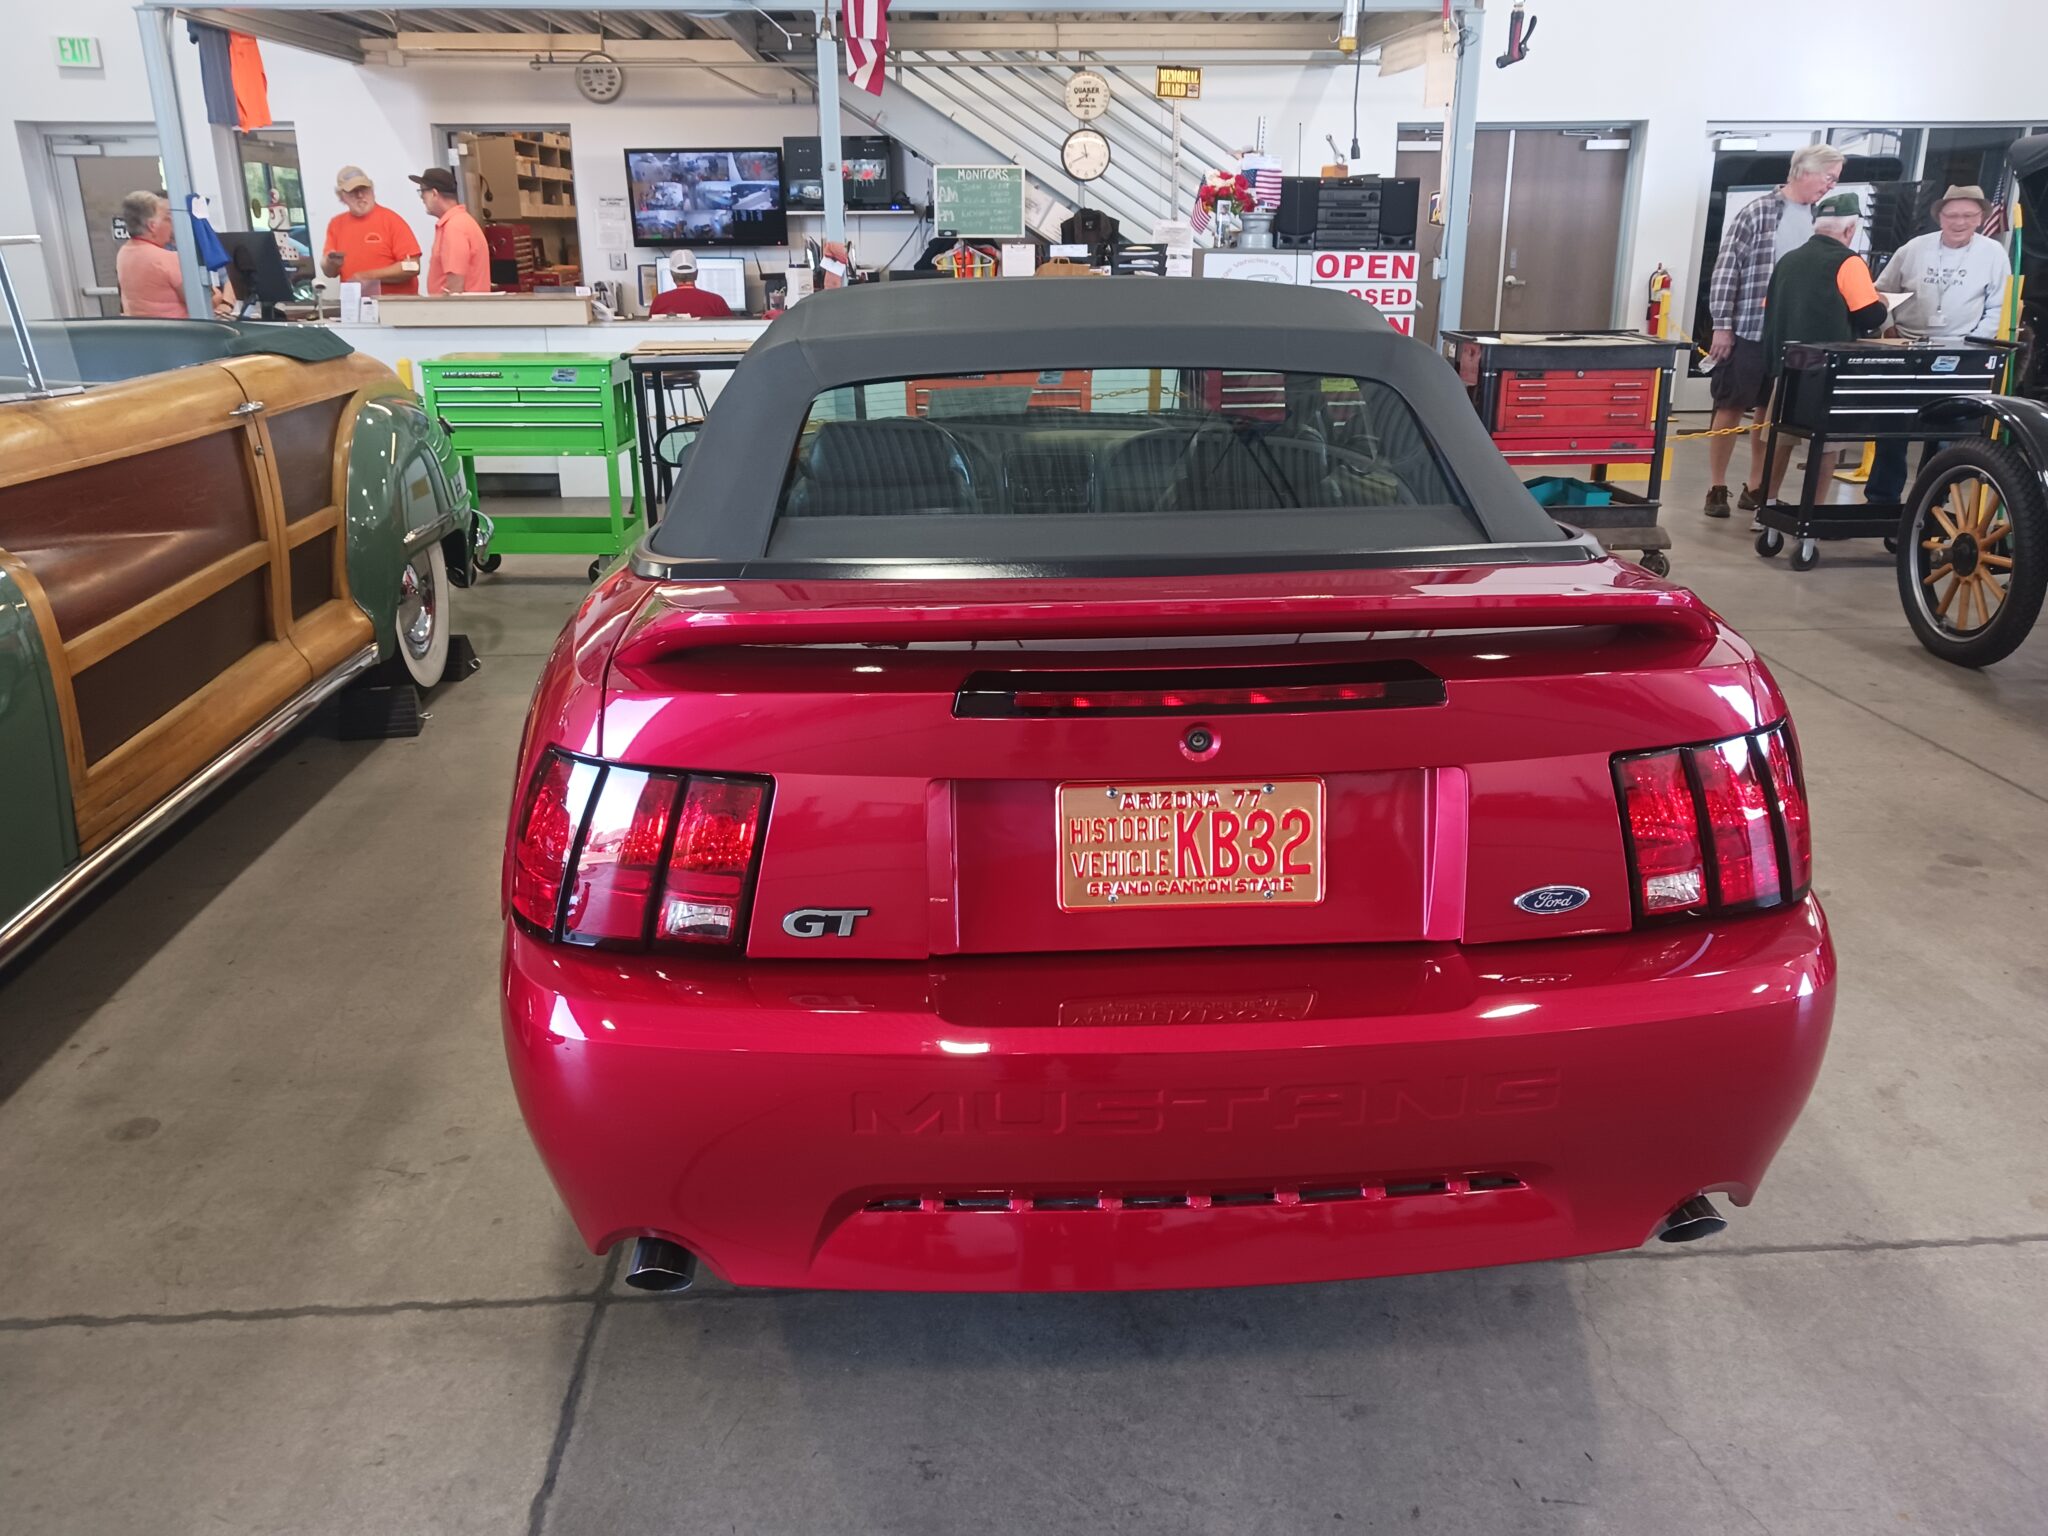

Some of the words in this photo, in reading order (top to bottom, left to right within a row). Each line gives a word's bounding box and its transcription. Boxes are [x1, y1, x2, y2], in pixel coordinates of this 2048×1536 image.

[58, 37, 91, 64] EXIT
[1160, 69, 1199, 83] MEMORIAL
[1159, 82, 1186, 96] AWARD
[958, 168, 1009, 181] MONITORS
[938, 186, 959, 203] AM
[1316, 254, 1415, 279] OPEN
[1119, 791, 1220, 811] ARIZONA
[1232, 789, 1262, 808] 77
[1070, 816, 1170, 844] HISTORIC
[1174, 807, 1314, 879] KB32
[1070, 849, 1172, 879] VEHICLE
[1088, 880, 1151, 896] GRAND
[1155, 878, 1232, 897] CANYON
[1235, 876, 1295, 893] STATE
[1534, 891, 1574, 908] Ford
[782, 909, 869, 938] GT
[852, 1068, 1563, 1135] MUSTANG
